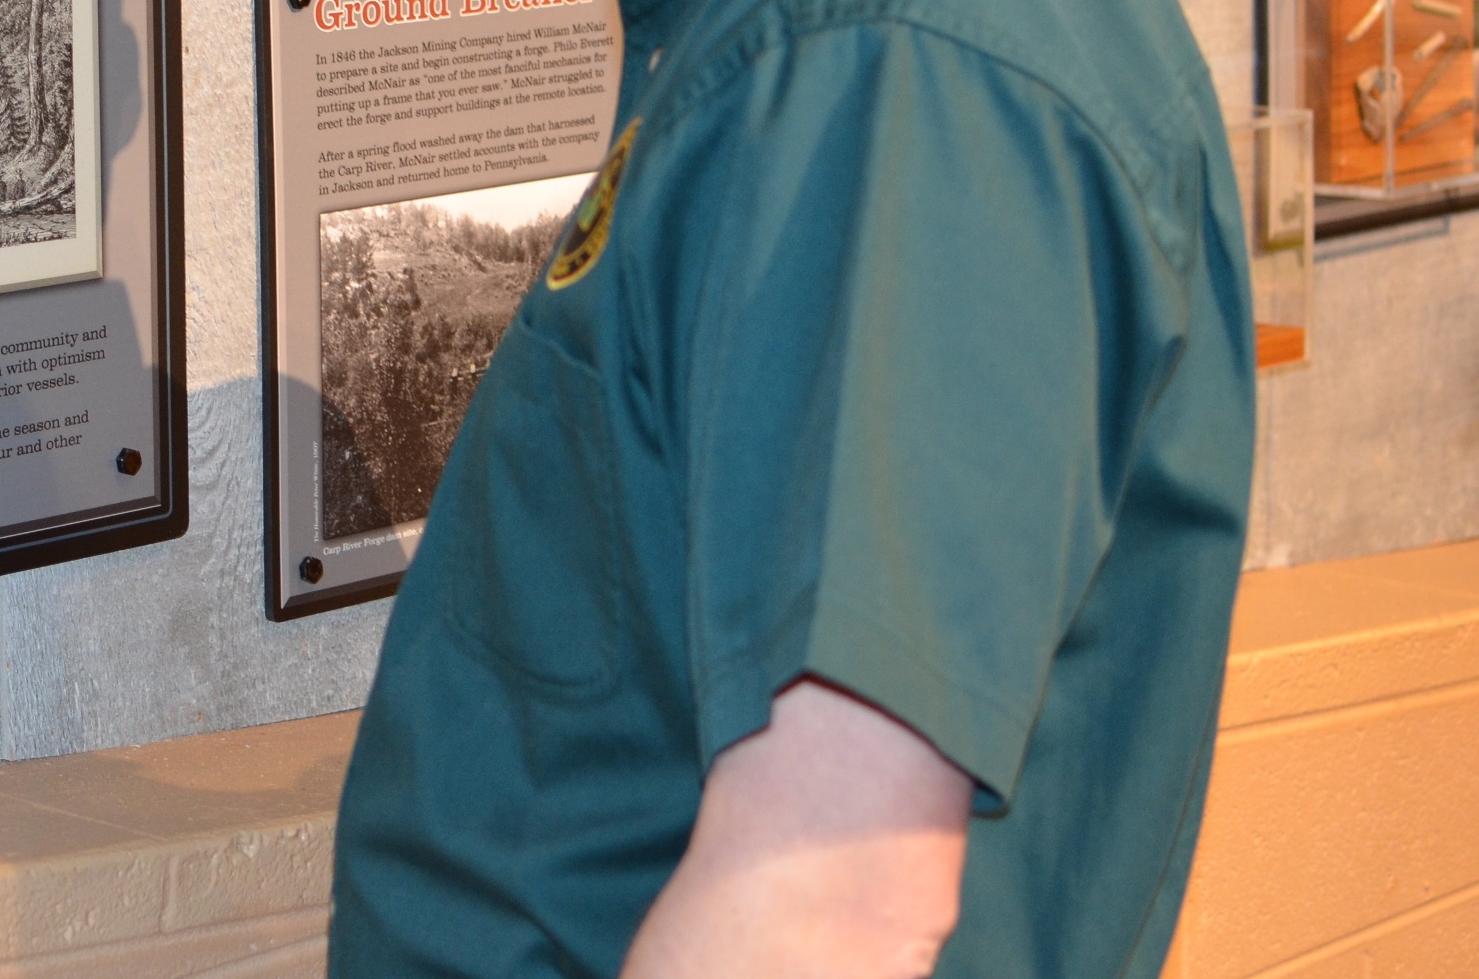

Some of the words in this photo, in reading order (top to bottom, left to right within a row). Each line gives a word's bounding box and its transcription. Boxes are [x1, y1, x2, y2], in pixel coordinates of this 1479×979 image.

[314, 53, 328, 65] In
[330, 49, 356, 63] 1846
[357, 48, 376, 60] the
[376, 45, 419, 57] Jackson
[420, 39, 458, 52] Mining
[458, 35, 504, 48] Company
[505, 29, 532, 42] hired
[532, 27, 570, 38] William
[570, 21, 607, 34] McNair
[315, 71, 327, 81] to
[328, 67, 369, 82] prepare
[370, 65, 378, 75] a
[379, 61, 399, 74] site
[400, 58, 420, 71] and
[421, 55, 450, 70] begin
[451, 49, 513, 64] constructing
[514, 48, 522, 57] a
[522, 45, 552, 57] forge.
[552, 39, 578, 52] Philo
[579, 36, 614, 49] Everett
[317, 150, 345, 163] After
[347, 150, 354, 159] a
[356, 144, 390, 159] spring
[392, 139, 417, 152] flood
[418, 133, 456, 148] washed
[458, 132, 483, 143] away
[485, 128, 501, 139] the
[503, 125, 524, 137] dam
[526, 122, 545, 133] that
[548, 114, 595, 130] harnessed
[318, 184, 329, 196] in
[330, 179, 374, 193] Jackson
[375, 173, 395, 187] and
[396, 167, 441, 184] returned
[442, 165, 470, 177] home
[471, 163, 482, 173] to
[483, 154, 550, 170] Pennsylvania.
[0, 332, 79, 355] community
[81, 324, 108, 341] and
[5, 358, 38, 374] with
[40, 349, 106, 371] optimism
[25, 372, 80, 391] vessels.
[12, 418, 61, 435] season
[63, 409, 90, 426] and
[16, 438, 42, 456] and
[45, 434, 82, 450] other
